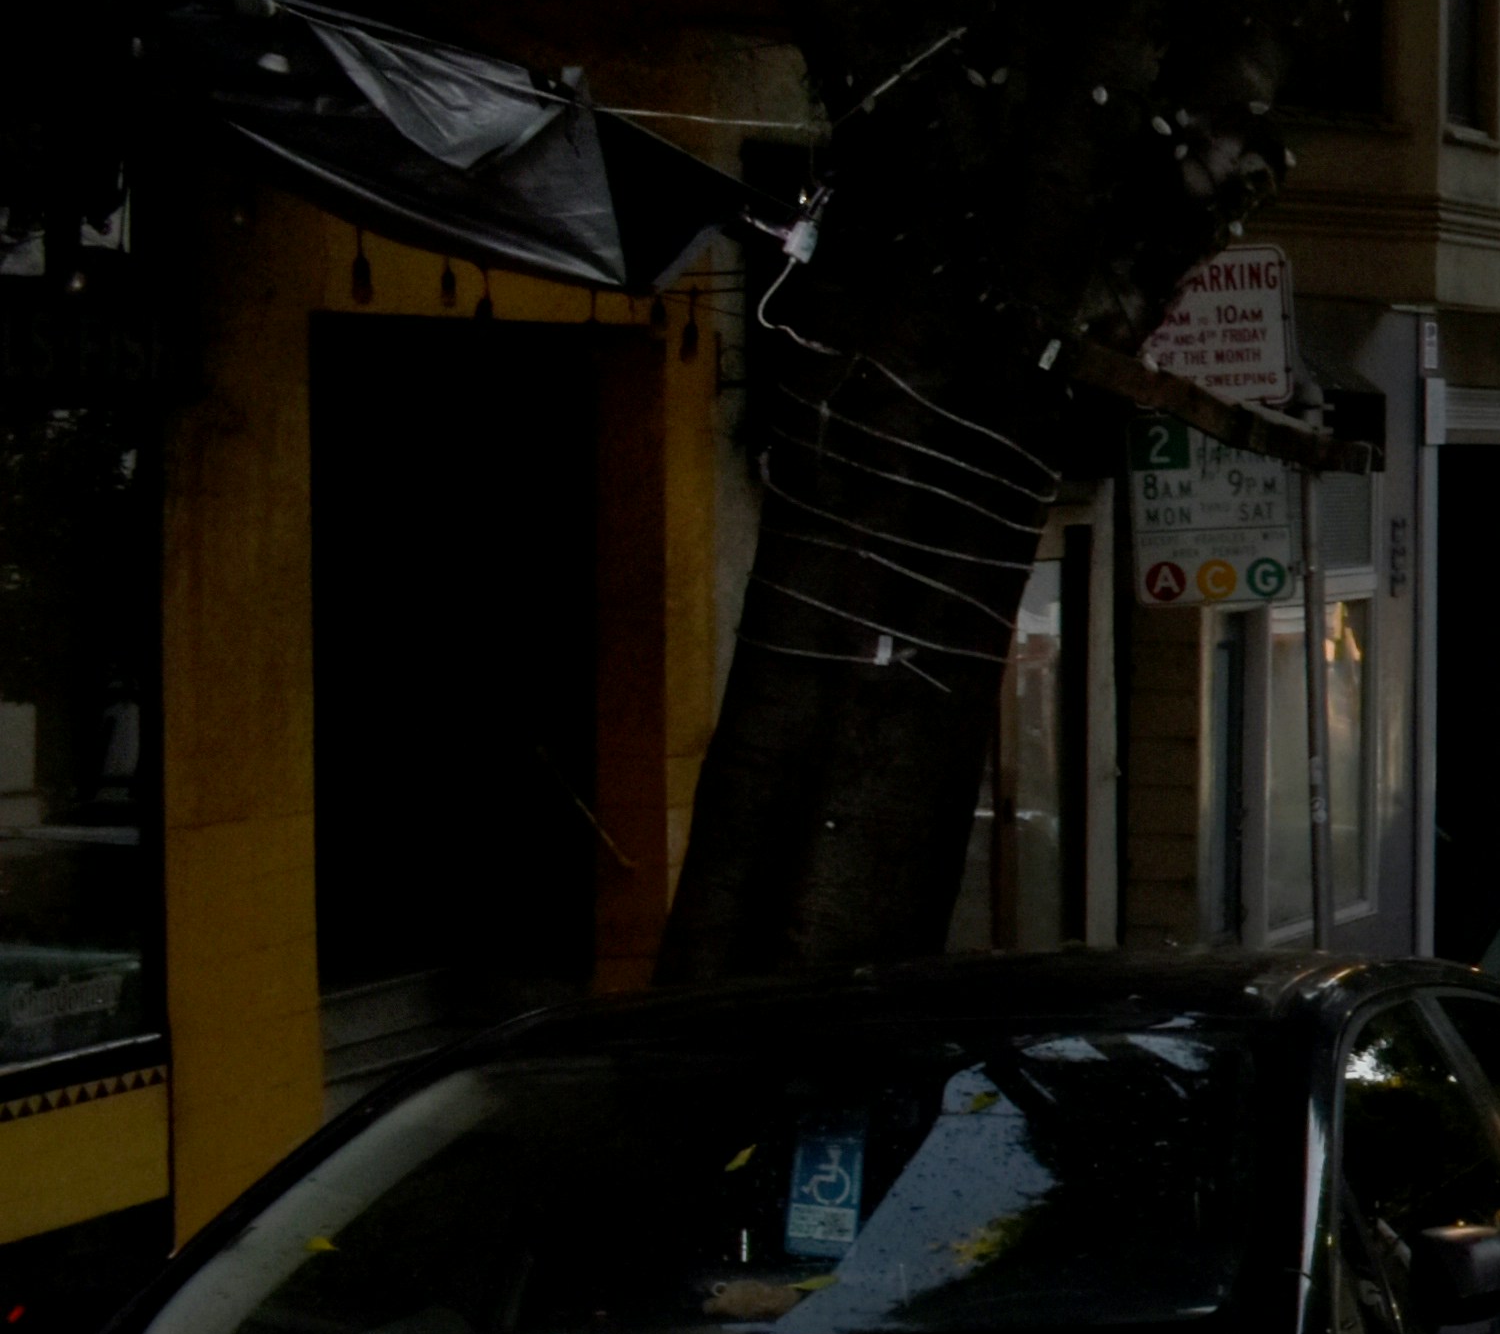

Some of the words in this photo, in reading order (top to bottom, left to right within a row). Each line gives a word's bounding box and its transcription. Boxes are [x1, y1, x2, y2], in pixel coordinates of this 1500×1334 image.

[1182, 261, 1278, 292] ARKING
[1215, 304, 1264, 324] 10AM
[1221, 327, 1268, 342] FRIDAY
[1184, 350, 1208, 365] THE
[1215, 348, 1262, 364] MONTH
[1205, 371, 1278, 387] SWEEPING
[1147, 424, 1171, 465] 2
[1145, 507, 1192, 526] MON
[1239, 502, 1275, 523] SAT
[1152, 564, 1182, 594] A
[1205, 565, 1228, 595] C
[1253, 562, 1281, 591] G
